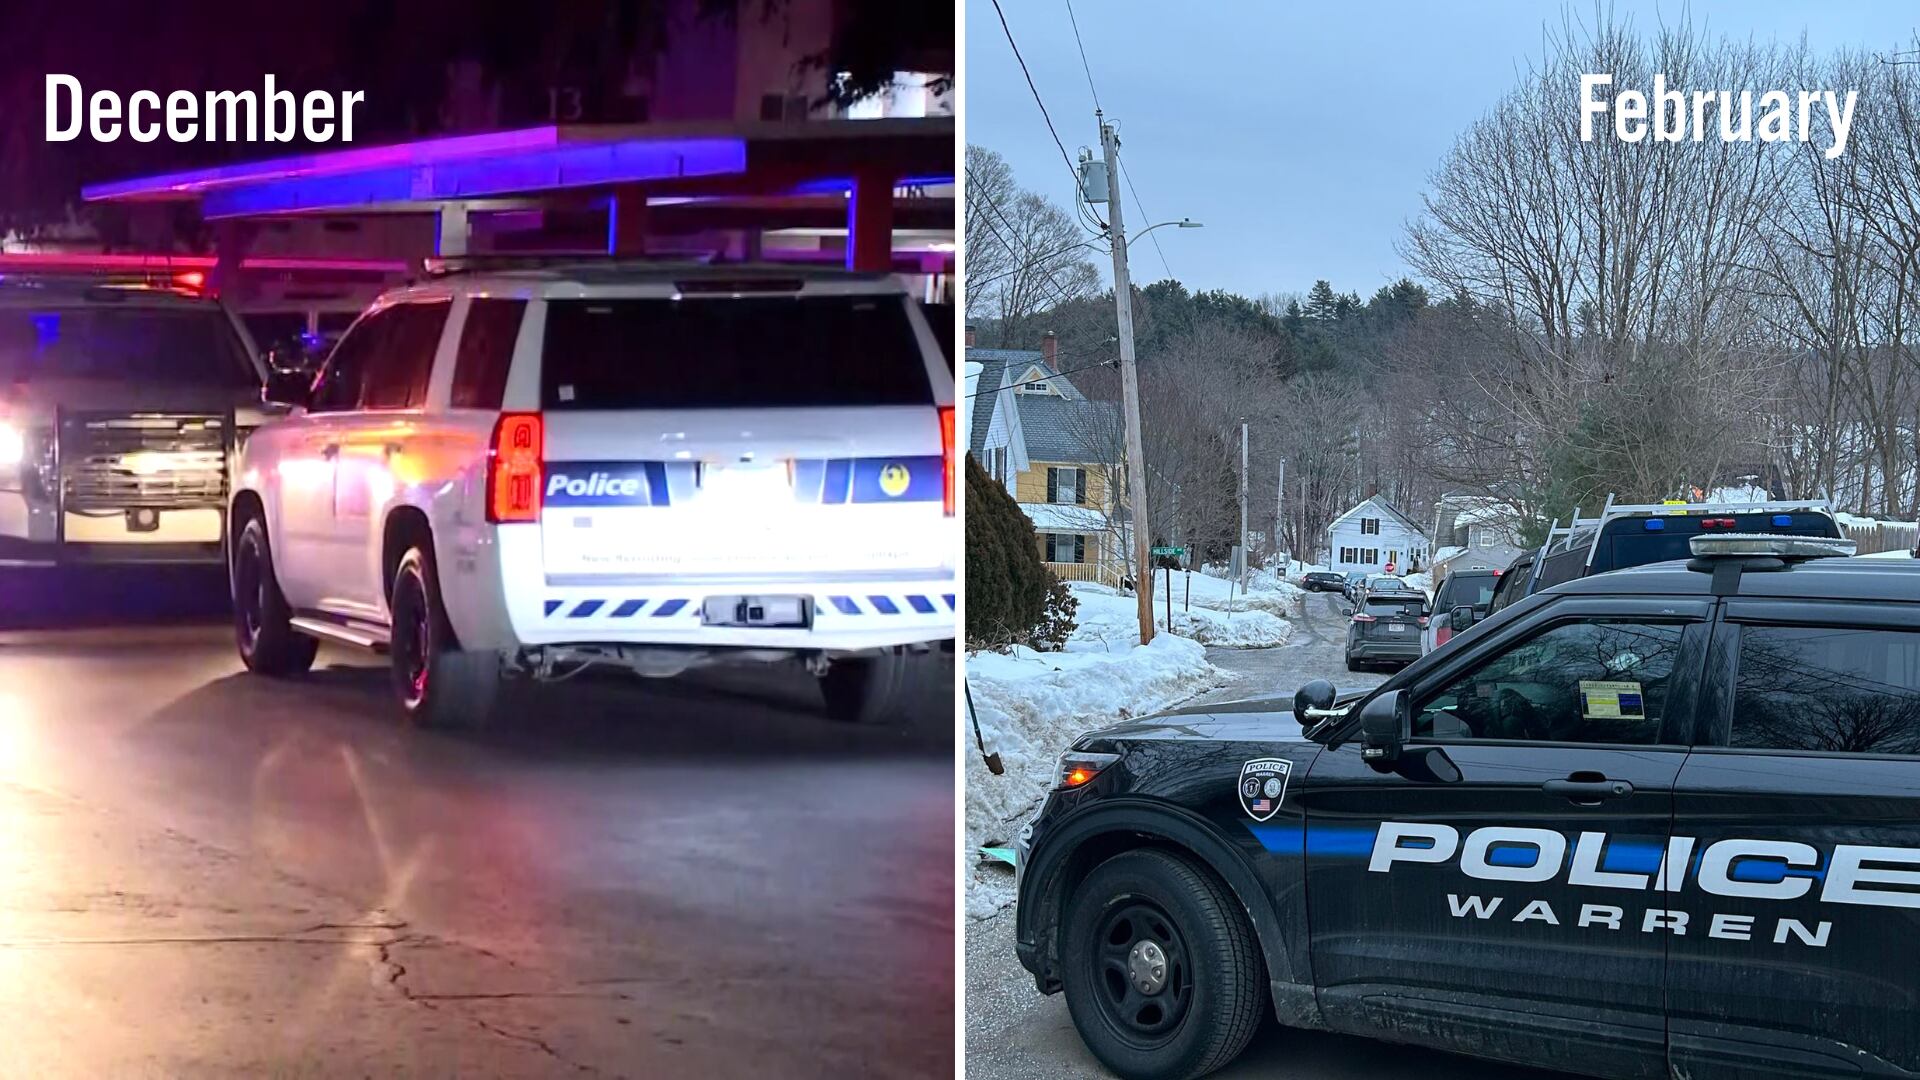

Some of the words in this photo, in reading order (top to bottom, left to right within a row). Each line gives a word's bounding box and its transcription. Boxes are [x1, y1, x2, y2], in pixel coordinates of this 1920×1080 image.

[546, 472, 639, 496] Police
[1249, 763, 1286, 772] POLICE
[1368, 821, 1920, 909] POLICE
[1447, 893, 1833, 947] WARREN
